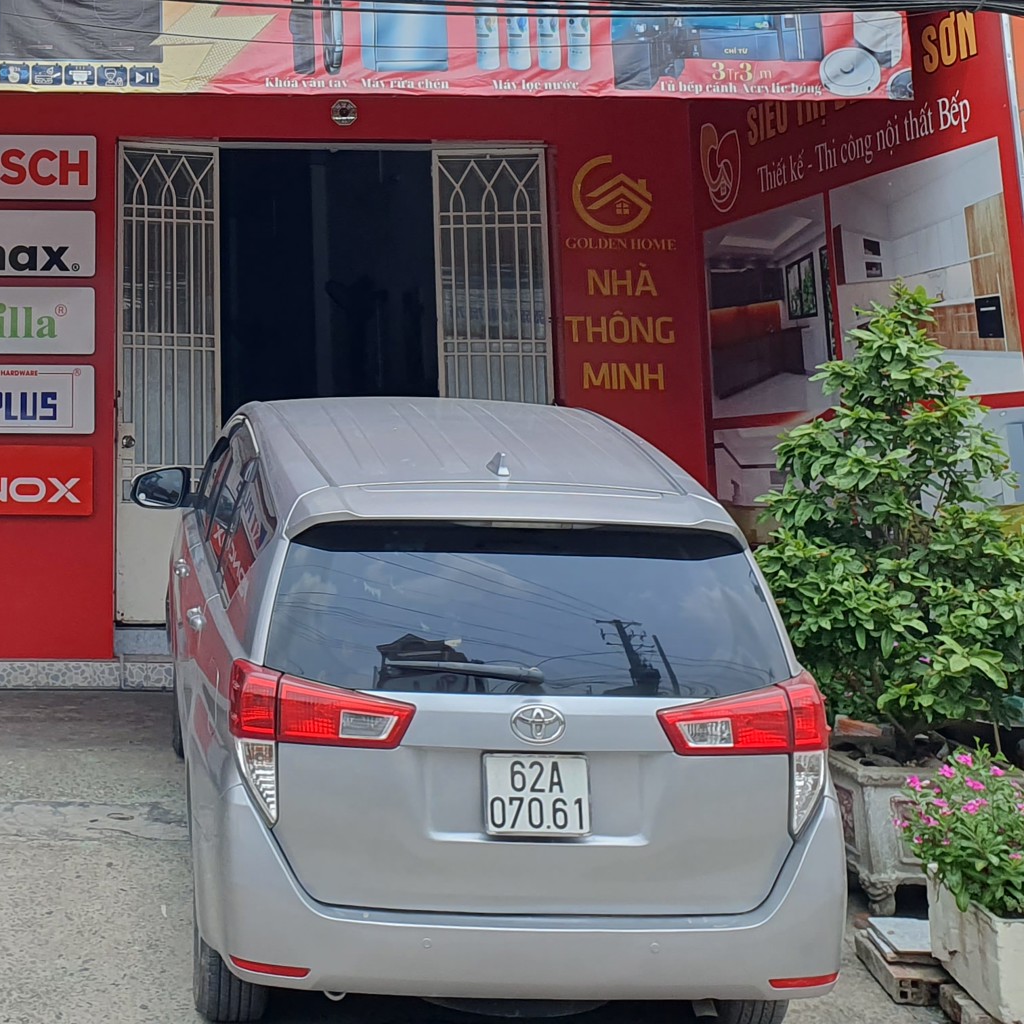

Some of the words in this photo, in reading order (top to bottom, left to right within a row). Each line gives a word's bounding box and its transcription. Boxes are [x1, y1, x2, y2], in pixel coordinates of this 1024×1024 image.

[840, 134, 873, 165] công
[937, 89, 972, 134] Bếp
[565, 236, 628, 251] GOLDEN
[630, 238, 676, 252] HOME
[587, 262, 657, 297] NHÀ
[564, 311, 676, 345] THÔNG
[583, 363, 665, 391] MINH
[510, 760, 564, 793] 62A
[489, 796, 584, 830] 070.61
